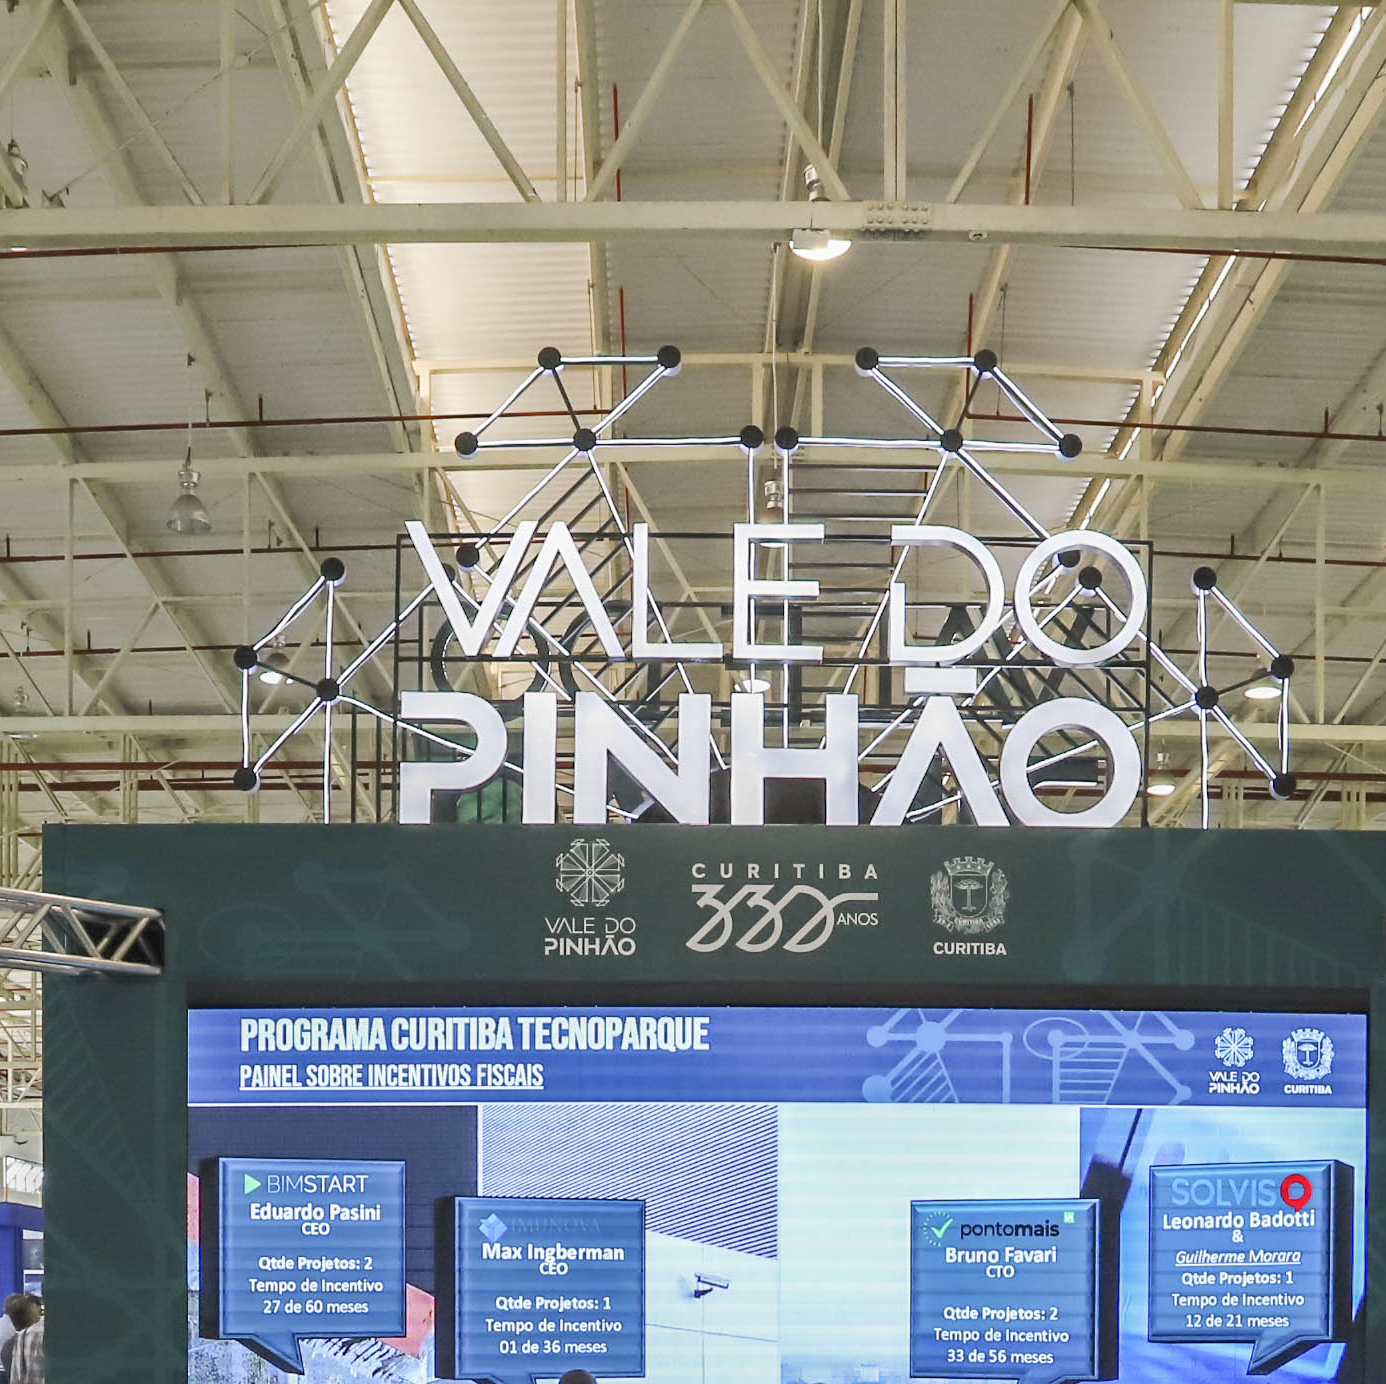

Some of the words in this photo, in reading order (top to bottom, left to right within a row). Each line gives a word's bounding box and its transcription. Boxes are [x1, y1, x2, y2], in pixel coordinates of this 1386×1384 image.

[404, 520, 825, 661] VALE
[891, 524, 1149, 667] DO
[398, 668, 1143, 826] PINHÃO
[692, 863, 878, 880] CURITIBA
[544, 917, 595, 934] VALE
[605, 917, 637, 934] DO
[837, 913, 879, 926] ANOS
[544, 935, 637, 956] PINHÃO
[933, 941, 1007, 956] CURITIBA
[240, 1016, 387, 1052] PROGRAMA
[391, 1016, 514, 1051] CURITIBA
[517, 1016, 711, 1053] TECNOPARQUE
[239, 1064, 302, 1088] PAINEL
[306, 1064, 365, 1087] SOBRE
[367, 1064, 472, 1087] INCENTIVOS
[476, 1063, 544, 1087] FISCAIS
[1209, 1071, 1239, 1082] VALE
[1241, 1071, 1261, 1083] DO
[1209, 1079, 1261, 1095] PINHÃO
[1284, 1084, 1333, 1095] CURITIBA
[266, 1174, 369, 1194] BIMSTART
[1171, 1177, 1277, 1207] SOLVIS
[249, 1202, 325, 1221] Eduardo
[329, 1202, 382, 1221] Pasini
[1162, 1212, 1245, 1230] Leonardo
[1248, 1209, 1315, 1228] Badotti
[301, 1222, 331, 1236] CEO
[960, 1219, 1060, 1240] pontomais
[1231, 1231, 1244, 1243] &
[482, 1243, 523, 1261] Max
[527, 1242, 625, 1265] Ingberman
[945, 1246, 1002, 1264] Bruno
[1005, 1246, 1057, 1263] Favari
[1176, 1249, 1246, 1265] Guilherme
[1248, 1248, 1302, 1264] Morara
[258, 1255, 294, 1273] Qtde
[296, 1255, 360, 1274] Projetos:
[364, 1255, 373, 1271] 2
[539, 1262, 569, 1276] CEO
[986, 1265, 1015, 1279] CTO
[249, 1278, 295, 1296] Tempo
[298, 1278, 317, 1293] de
[321, 1278, 384, 1293] Incentivo
[1181, 1271, 1216, 1287] Qtde
[1219, 1270, 1283, 1288] Projetos:
[1286, 1271, 1294, 1285] 1
[262, 1300, 281, 1315] 27
[284, 1299, 302, 1314] de
[305, 1299, 323, 1314] 60
[326, 1302, 369, 1315] meses
[495, 1295, 532, 1313] Qtde
[535, 1295, 599, 1314] Projetos:
[603, 1296, 612, 1311] 1
[1171, 1293, 1218, 1310] Tempo
[1221, 1292, 1240, 1307] de
[1243, 1292, 1305, 1307] Incentivo
[943, 1306, 978, 1322] Qtde
[981, 1306, 1046, 1324] Projetos:
[1049, 1306, 1059, 1321] 2
[1186, 1314, 1202, 1328] 12
[1205, 1314, 1224, 1328] de
[1226, 1313, 1243, 1328] 21
[1246, 1316, 1290, 1328] meses
[485, 1318, 532, 1336] Tempo
[536, 1318, 555, 1333] de
[559, 1318, 623, 1333] Incentivo
[933, 1327, 981, 1345] Tempo
[983, 1328, 1003, 1343] de
[1006, 1328, 1070, 1344] Incentivo
[499, 1340, 518, 1355] 01
[521, 1339, 540, 1354] de
[542, 1339, 561, 1354] 36
[564, 1342, 608, 1354] meses
[947, 1349, 966, 1363] 33
[968, 1349, 987, 1364] de
[989, 1349, 1007, 1363] 56
[1010, 1352, 1054, 1364] meses
